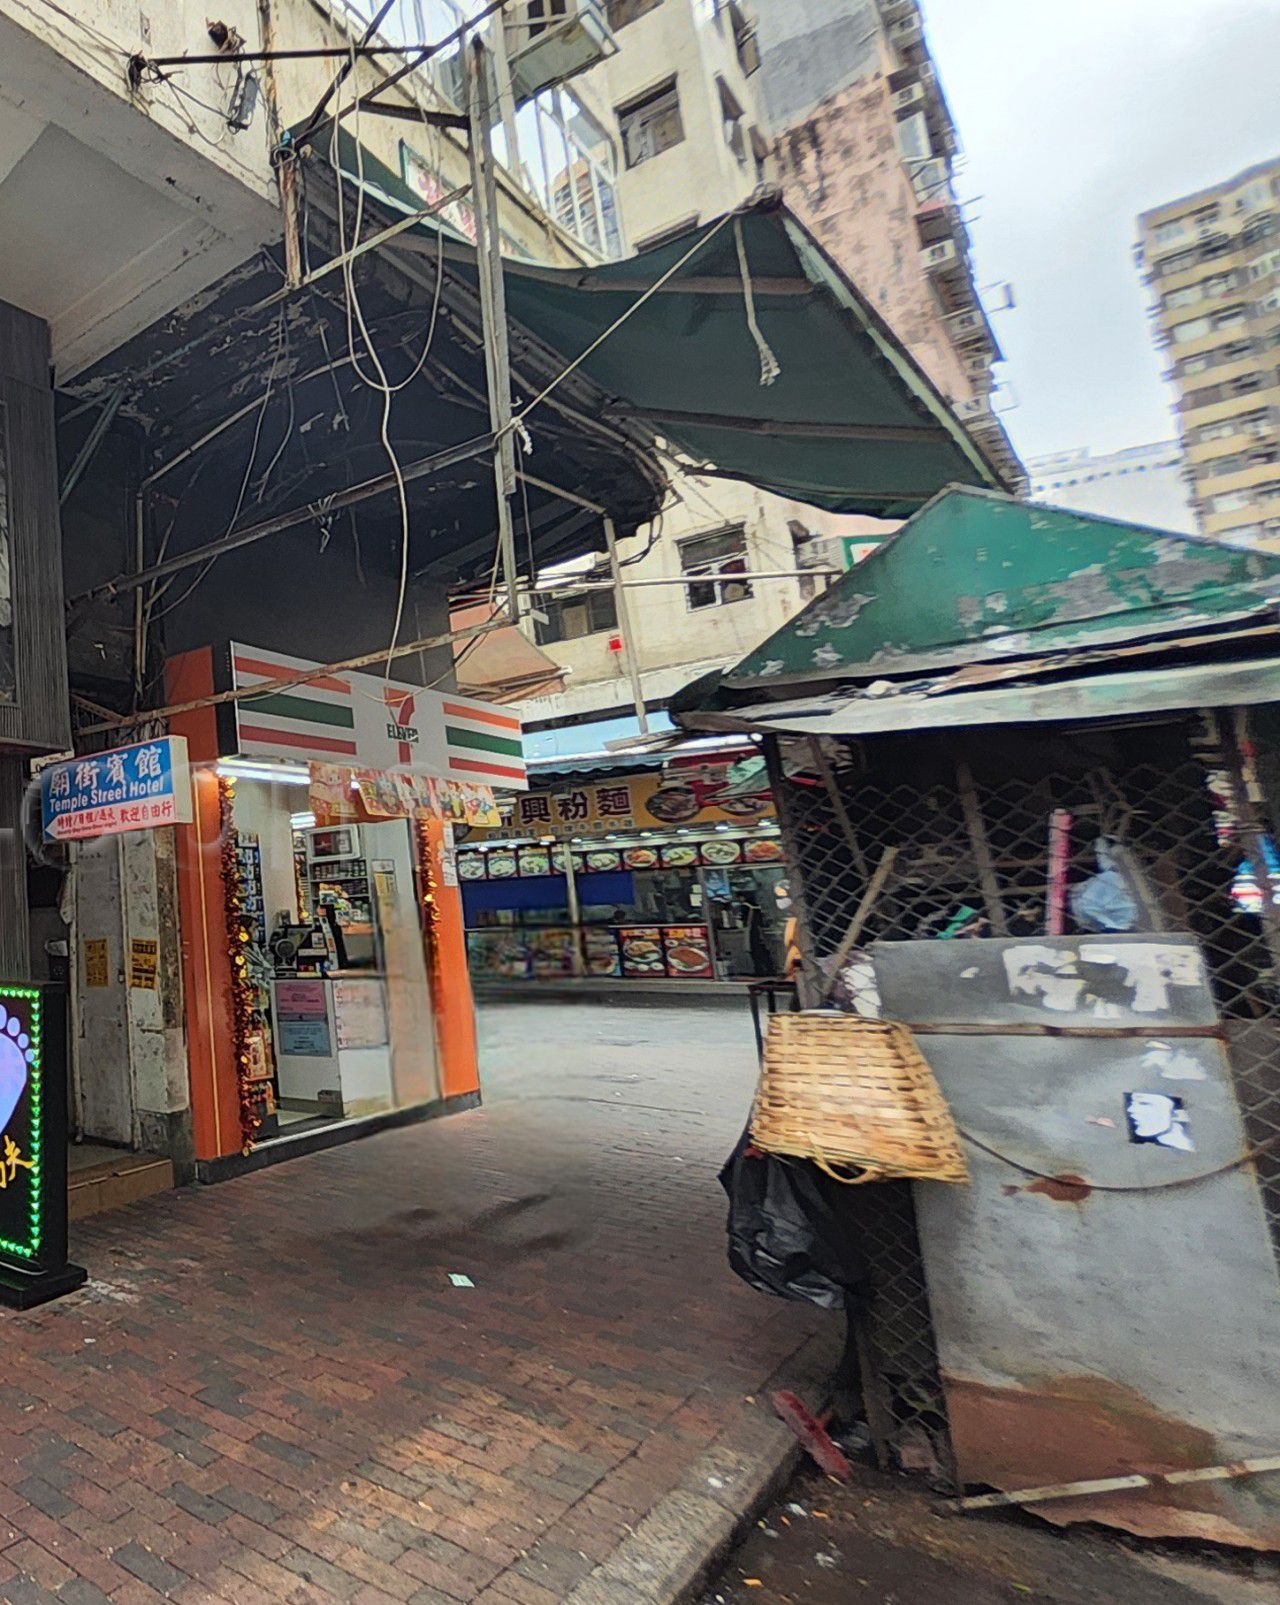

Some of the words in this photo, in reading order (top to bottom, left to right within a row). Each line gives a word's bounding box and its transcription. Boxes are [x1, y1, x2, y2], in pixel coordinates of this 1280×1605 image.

[49, 745, 163, 797] 廟街賓館
[50, 793, 88, 813] Temple
[91, 783, 126, 805] Street
[130, 776, 164, 797] Hotel
